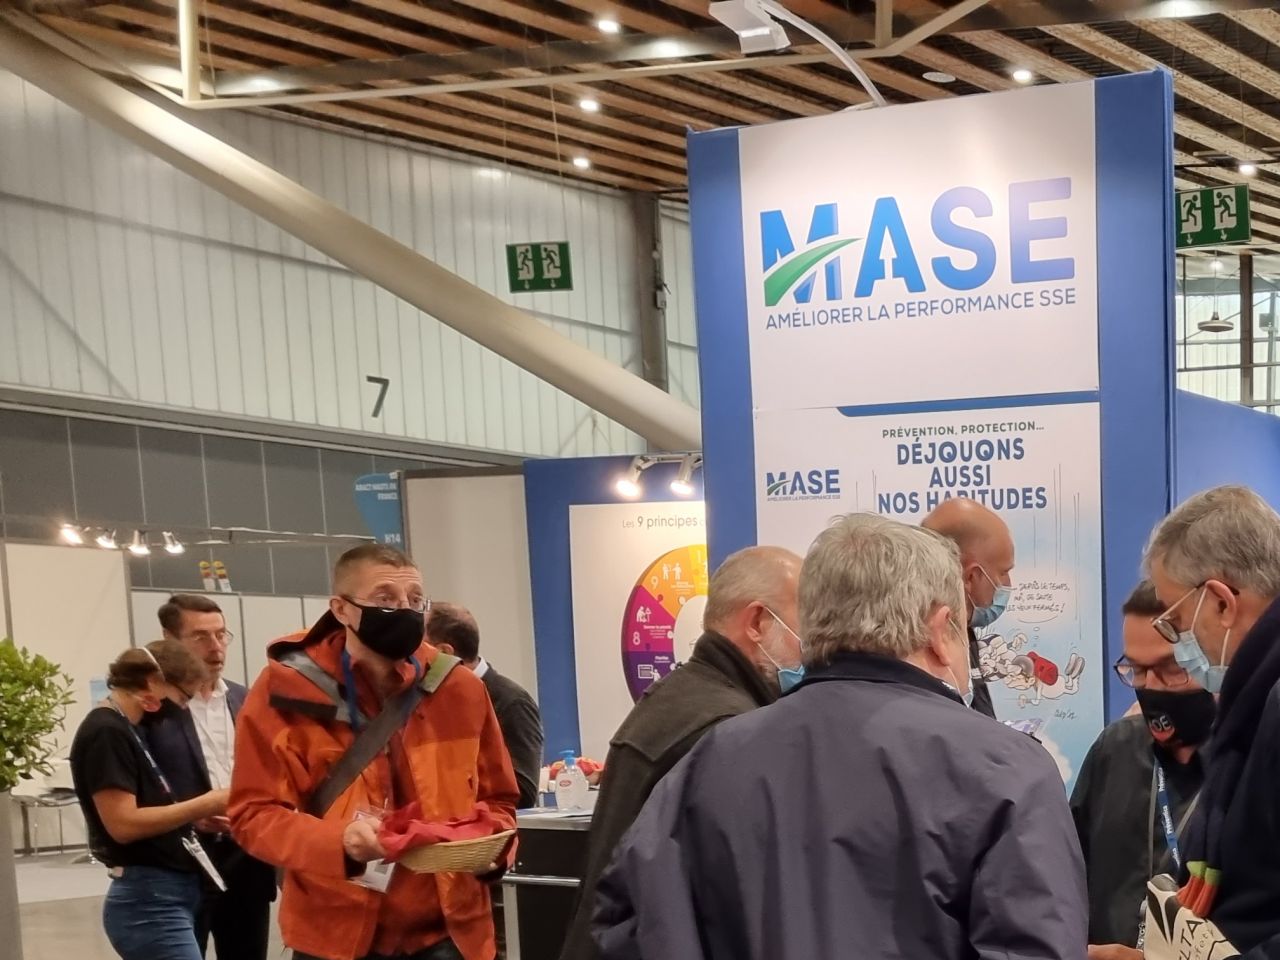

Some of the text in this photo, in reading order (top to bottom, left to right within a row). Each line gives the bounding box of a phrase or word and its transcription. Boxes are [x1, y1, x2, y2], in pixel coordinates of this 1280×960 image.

[760, 177, 1075, 307] MASE
[766, 288, 1076, 330] AMÉLIORER LA PERFORMANCE SSE
[366, 375, 390, 418] 7
[897, 437, 1025, 465] DÉJOUONS
[766, 469, 840, 496] MASE
[929, 464, 991, 488] AUSSI
[878, 491, 920, 514] NOS
[637, 515, 644, 527] 9
[646, 514, 698, 530] principes
[650, 575, 659, 590] 9
[632, 630, 641, 646] 8
